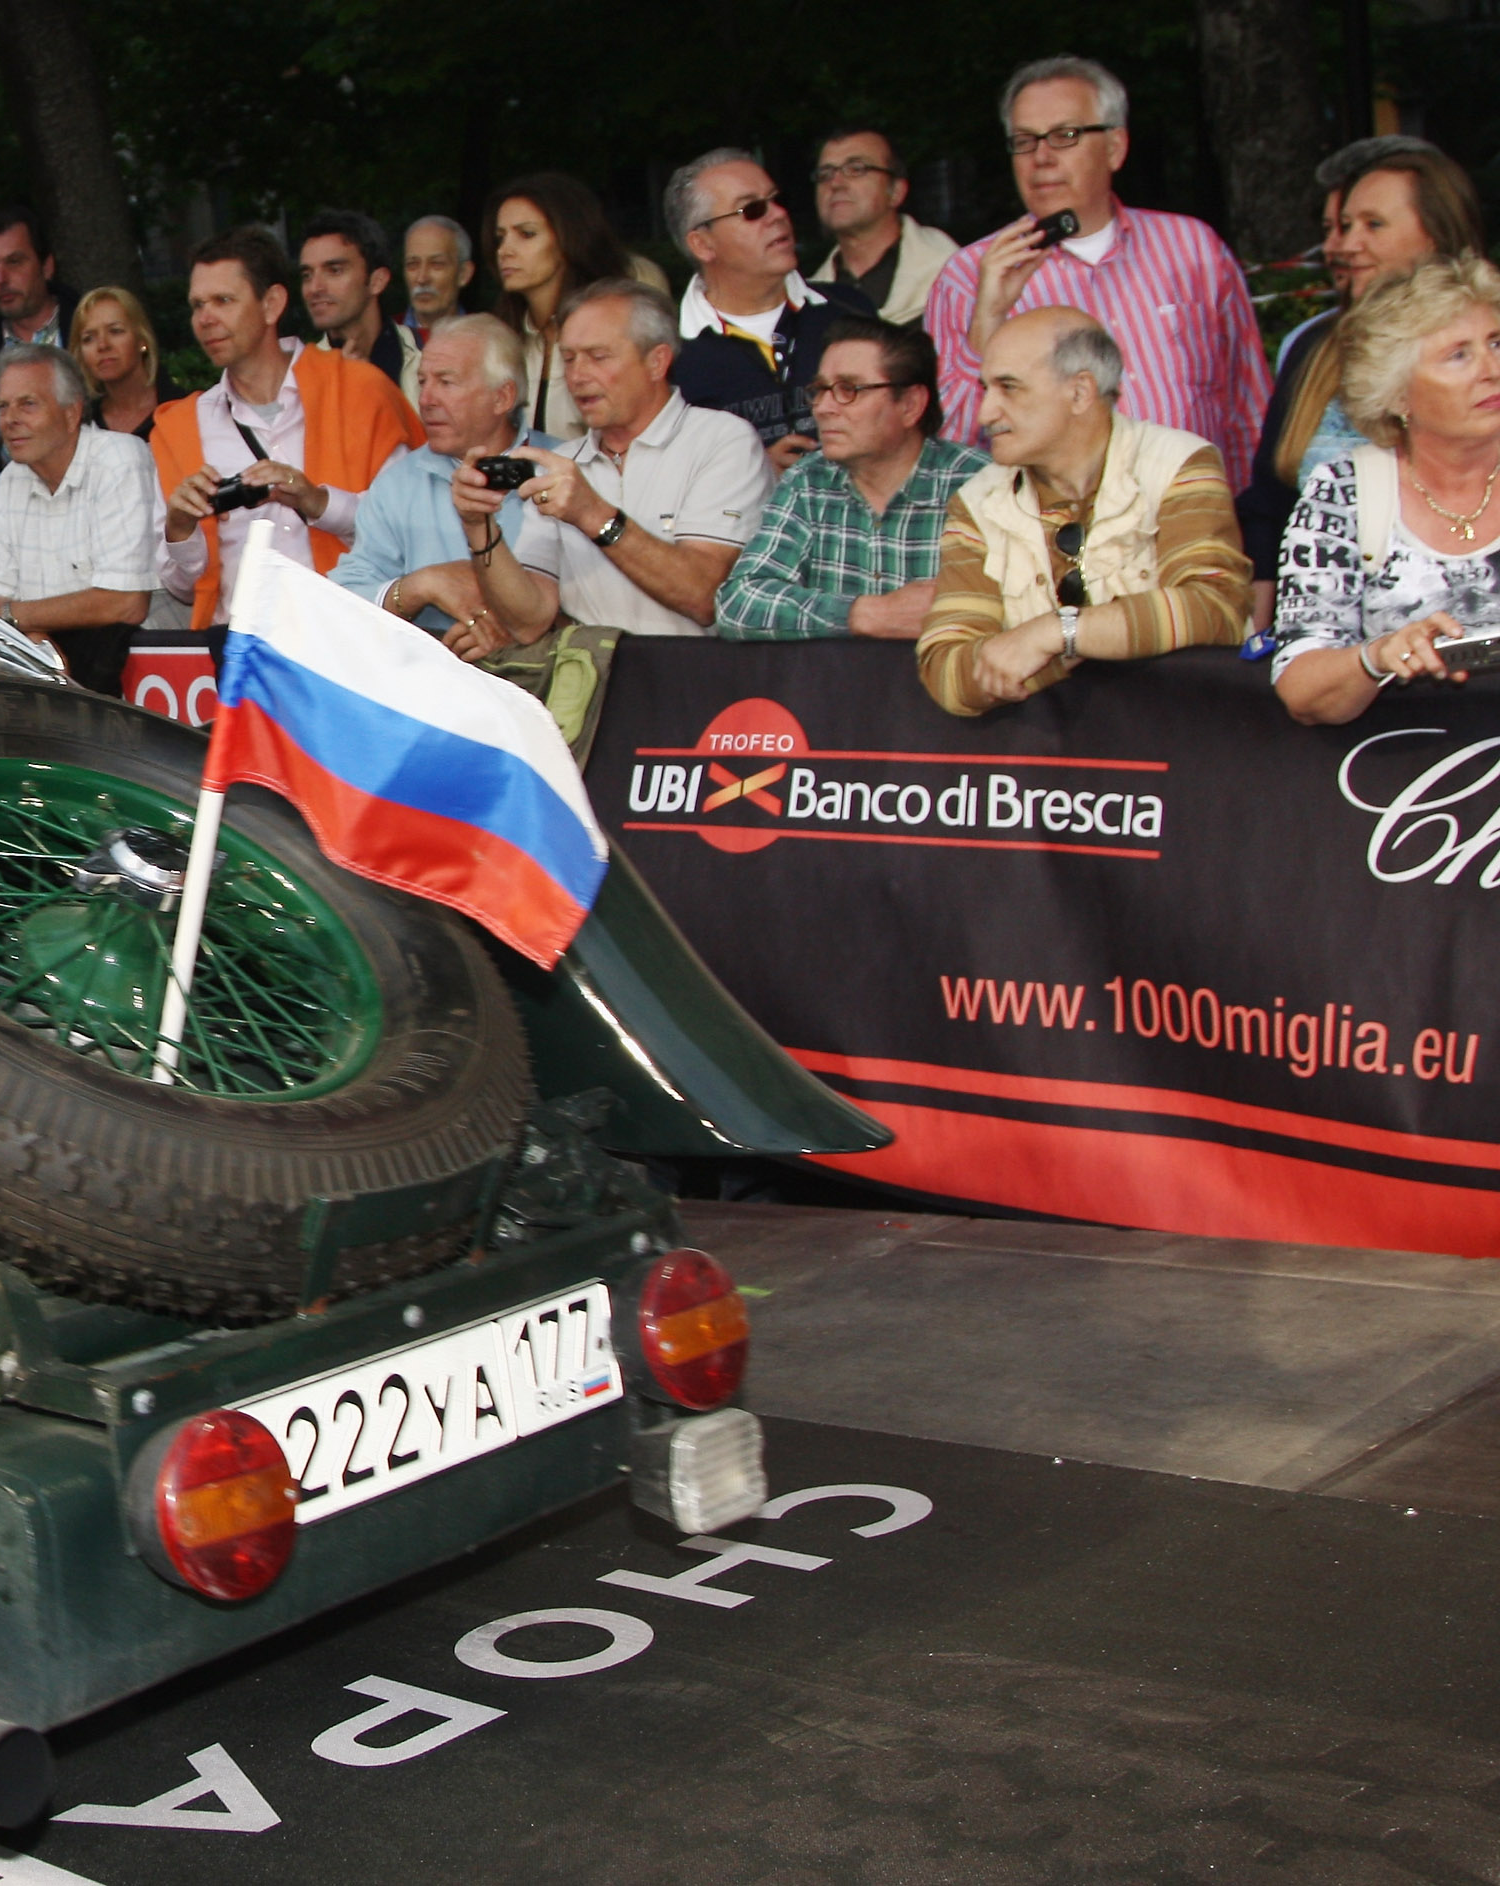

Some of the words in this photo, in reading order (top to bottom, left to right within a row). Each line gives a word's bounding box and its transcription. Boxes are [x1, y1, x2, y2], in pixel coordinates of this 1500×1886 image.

[709, 734, 794, 752] TROFEO
[629, 764, 703, 813] UBI
[788, 768, 931, 825] Banco
[937, 774, 978, 826] di
[988, 774, 1163, 837] Brescia
[940, 975, 1479, 1083] www.1000miglia.eu
